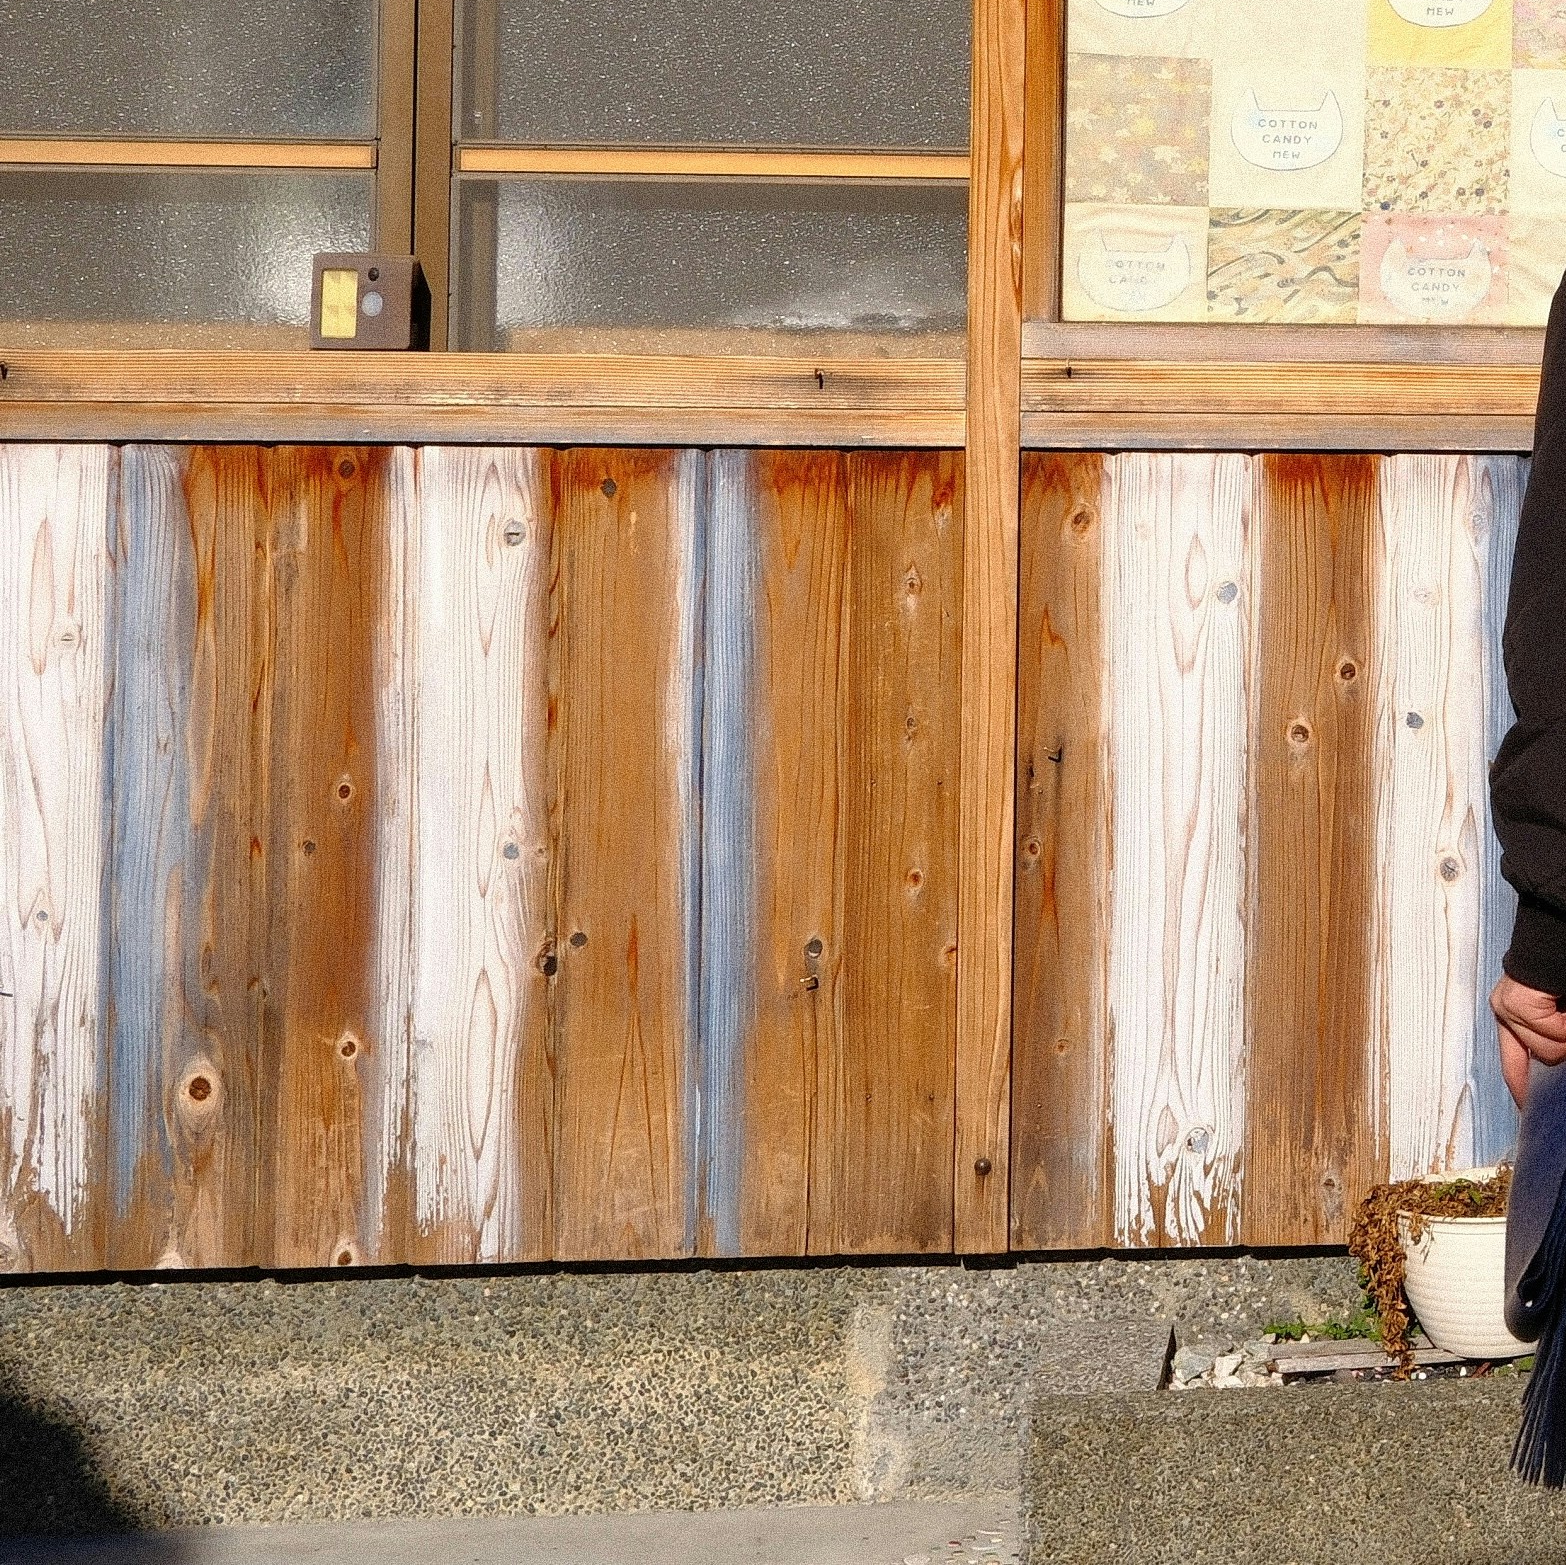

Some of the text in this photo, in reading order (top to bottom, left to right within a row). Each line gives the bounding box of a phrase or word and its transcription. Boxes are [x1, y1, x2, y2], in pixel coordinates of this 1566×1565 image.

[1425, 6, 1456, 17] MEW
[1257, 118, 1319, 132] COTTON
[1261, 133, 1313, 147] CANDY
[1271, 149, 1302, 161] MEW
[1407, 267, 1467, 280] COTTON
[1410, 281, 1462, 293] CANDY
